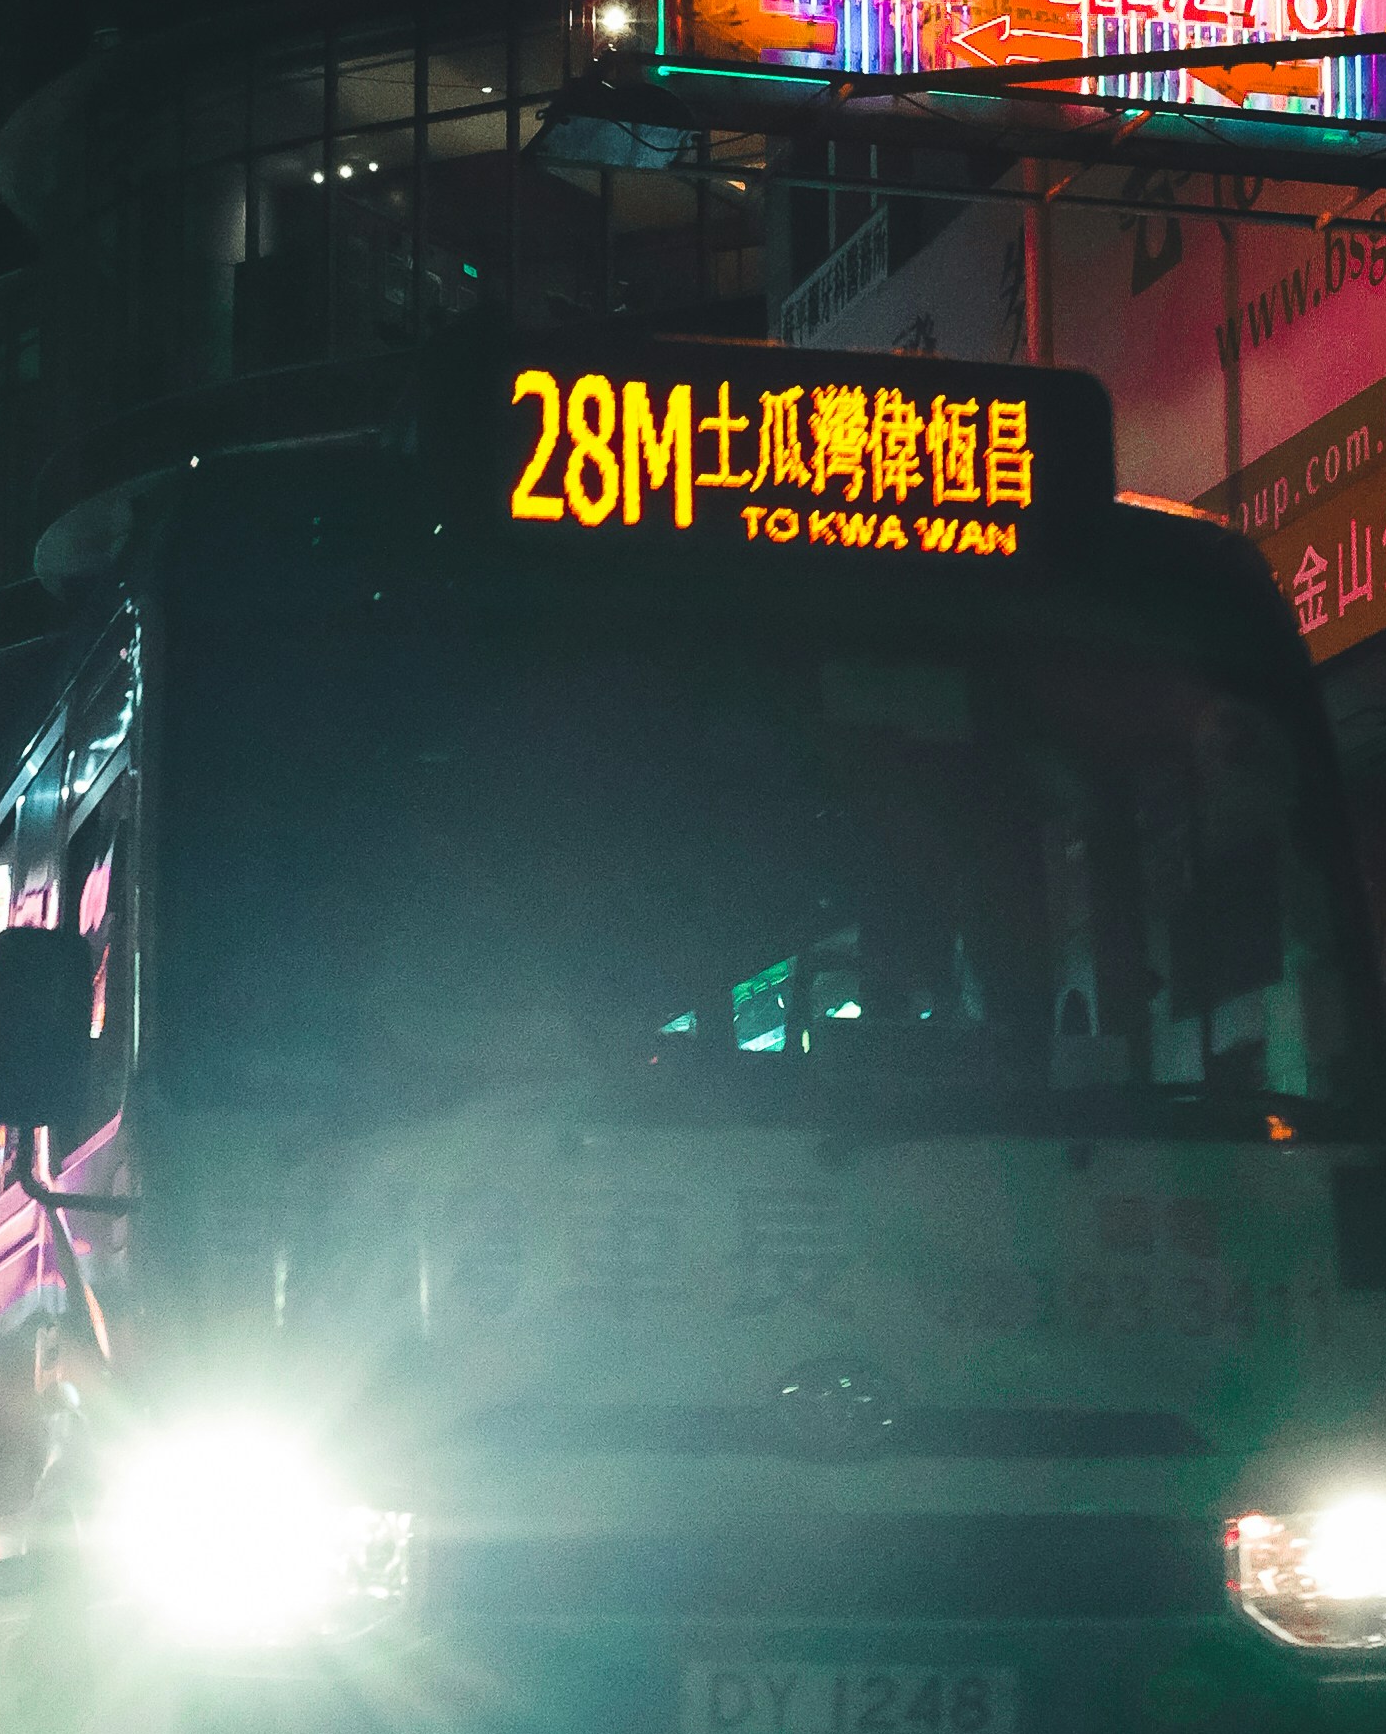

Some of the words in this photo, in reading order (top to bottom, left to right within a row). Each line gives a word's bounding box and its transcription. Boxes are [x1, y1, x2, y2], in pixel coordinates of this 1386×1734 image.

[511, 370, 692, 529] 28M
[741, 506, 802, 543] TO
[810, 510, 909, 551] KWA
[914, 516, 1017, 556] WAN
[832, 1674, 993, 1733] 1248
